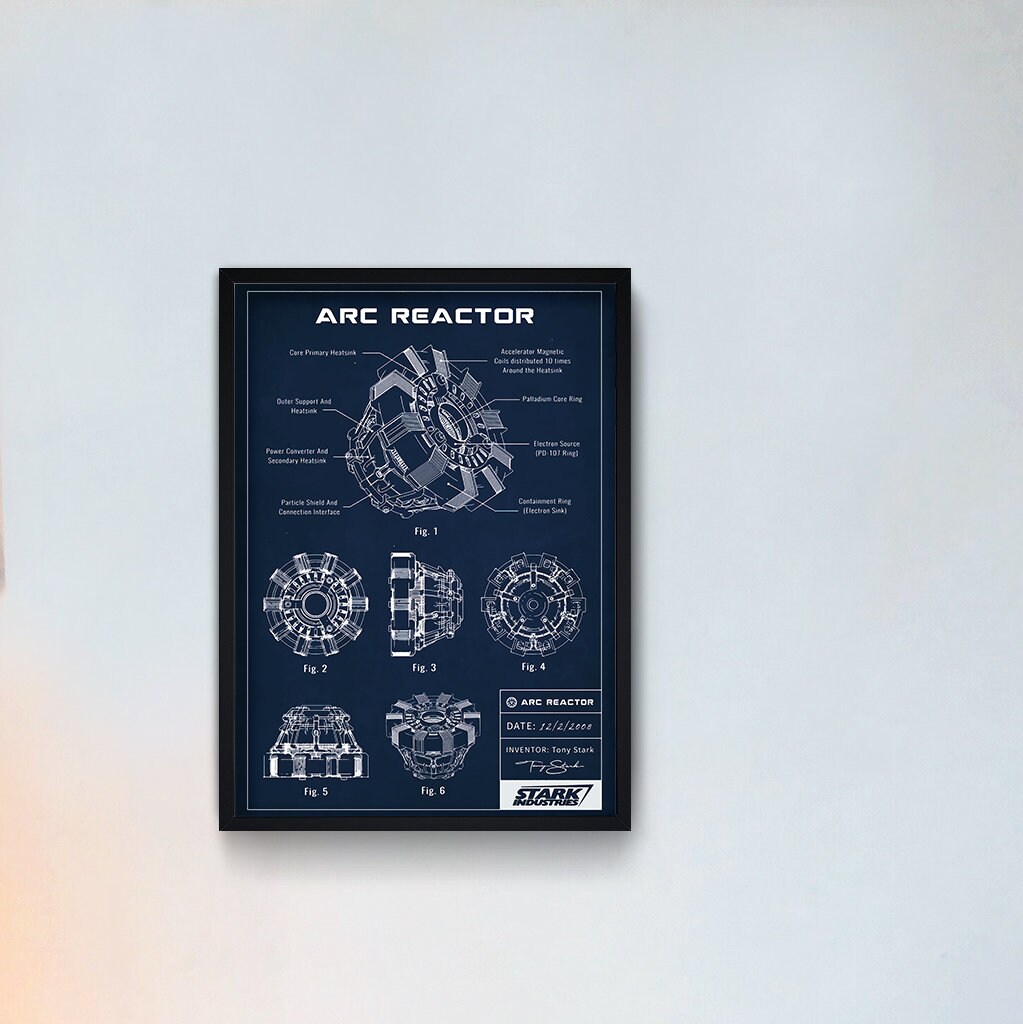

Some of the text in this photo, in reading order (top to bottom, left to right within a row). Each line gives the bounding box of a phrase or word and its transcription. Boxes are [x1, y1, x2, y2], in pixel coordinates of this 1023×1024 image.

[316, 308, 534, 324] ARC REACTOR
[290, 349, 303, 357] Core
[305, 349, 329, 357] Primary
[537, 349, 564, 357] Magnetic
[295, 398, 318, 406] Support
[569, 396, 582, 404] Ring
[560, 440, 580, 448] Source
[562, 450, 578, 458] Ring)
[268, 457, 298, 465] Secondary
[281, 499, 304, 507] Particle
[306, 499, 324, 507] Shield
[558, 498, 571, 506] Ring
[523, 507, 567, 515] (Electron Sink)
[415, 527, 438, 537] Fig. 1
[304, 664, 328, 674] Fig. 2
[413, 663, 437, 673] Fig. 3
[522, 662, 546, 672] Fig. 4
[507, 720, 592, 731] DATE: 12/2/2008
[506, 746, 549, 754] INVENTOR:
[552, 747, 571, 756] Tony
[305, 787, 329, 797] Fig. 5
[422, 786, 446, 796] Fig. 6
[515, 788, 583, 799] STARK
